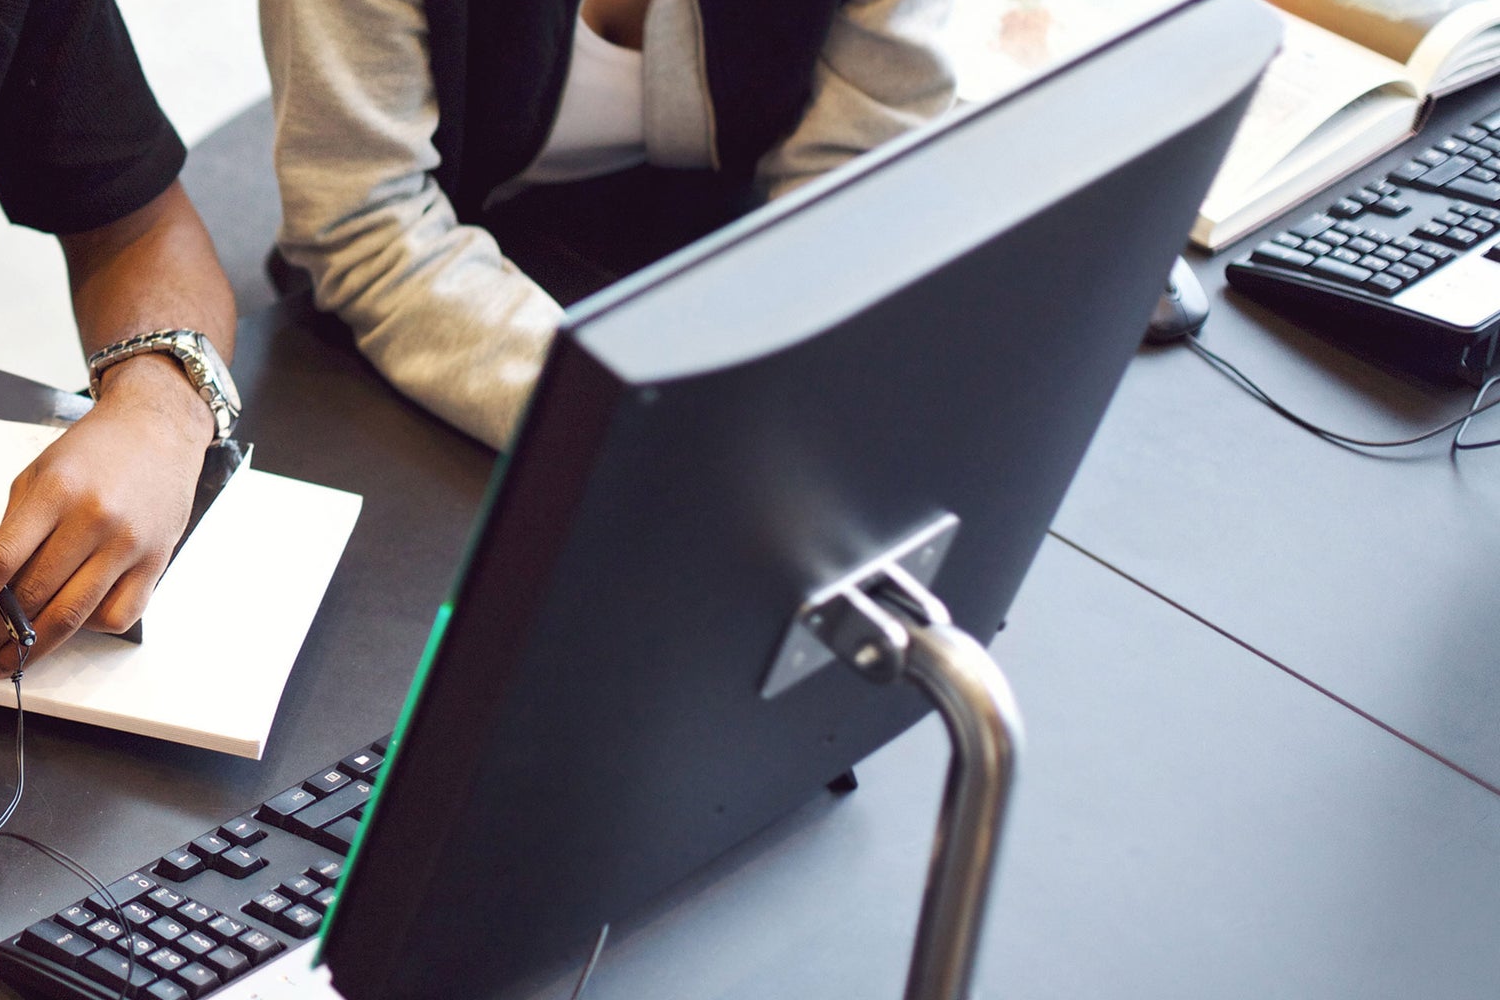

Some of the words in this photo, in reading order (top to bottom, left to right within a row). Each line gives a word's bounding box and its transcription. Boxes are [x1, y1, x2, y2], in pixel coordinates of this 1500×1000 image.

[138, 880, 149, 888] 0
[140, 909, 150, 918] 2
[198, 906, 208, 917] 4
[108, 925, 120, 934] 3
[168, 924, 180, 933] 5
[230, 921, 241, 930] 7
[137, 941, 149, 949] 6
[199, 940, 211, 949] 8
[168, 955, 180, 964] 9
